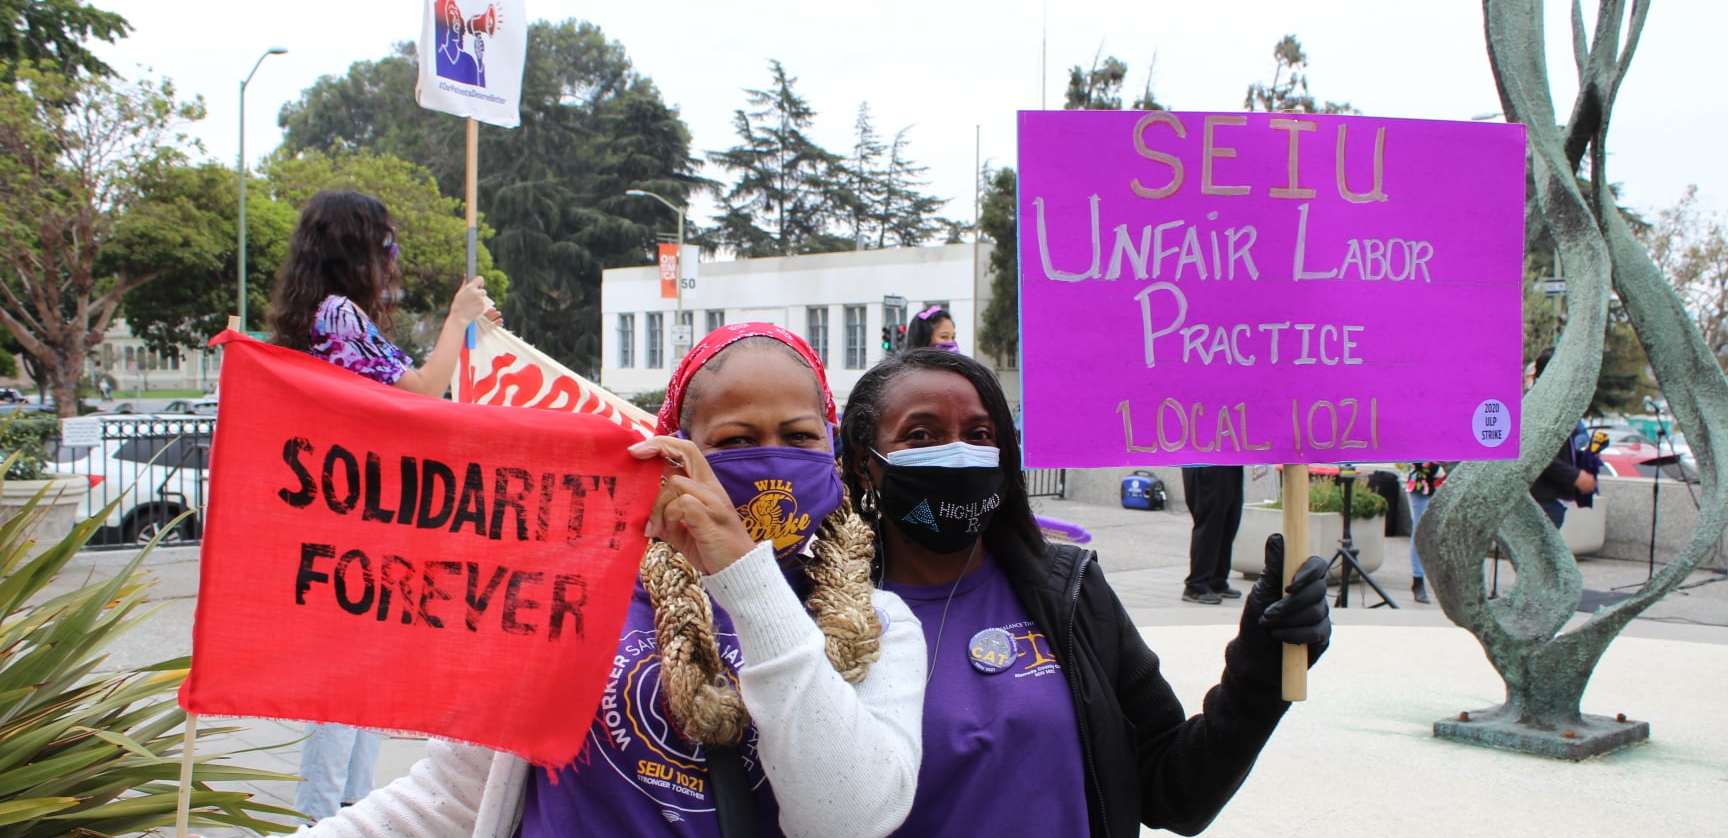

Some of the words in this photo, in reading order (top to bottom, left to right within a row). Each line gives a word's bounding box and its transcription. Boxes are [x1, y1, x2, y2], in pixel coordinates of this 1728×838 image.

[1130, 111, 1388, 203] SEIU
[1293, 203, 1434, 283] LABOR
[1134, 282, 1365, 368] PRACTICE
[1484, 403, 1500, 413] 2020
[1485, 416, 1497, 426] ULP
[1115, 398, 1273, 453] LOCAL
[1292, 397, 1379, 455] 1021
[1481, 430, 1502, 440] STRIKE
[277, 436, 628, 551] SOLIDARITY
[754, 479, 793, 493] WILL
[939, 493, 1000, 519] HIGHLAND
[295, 543, 587, 643] FOREVER
[971, 646, 1009, 668] CAT
[601, 654, 631, 752] WORKER
[637, 759, 674, 781] SEIU
[676, 771, 704, 793] 1021
[637, 774, 671, 789] STRONGER
[672, 783, 705, 800] TOGETHER
